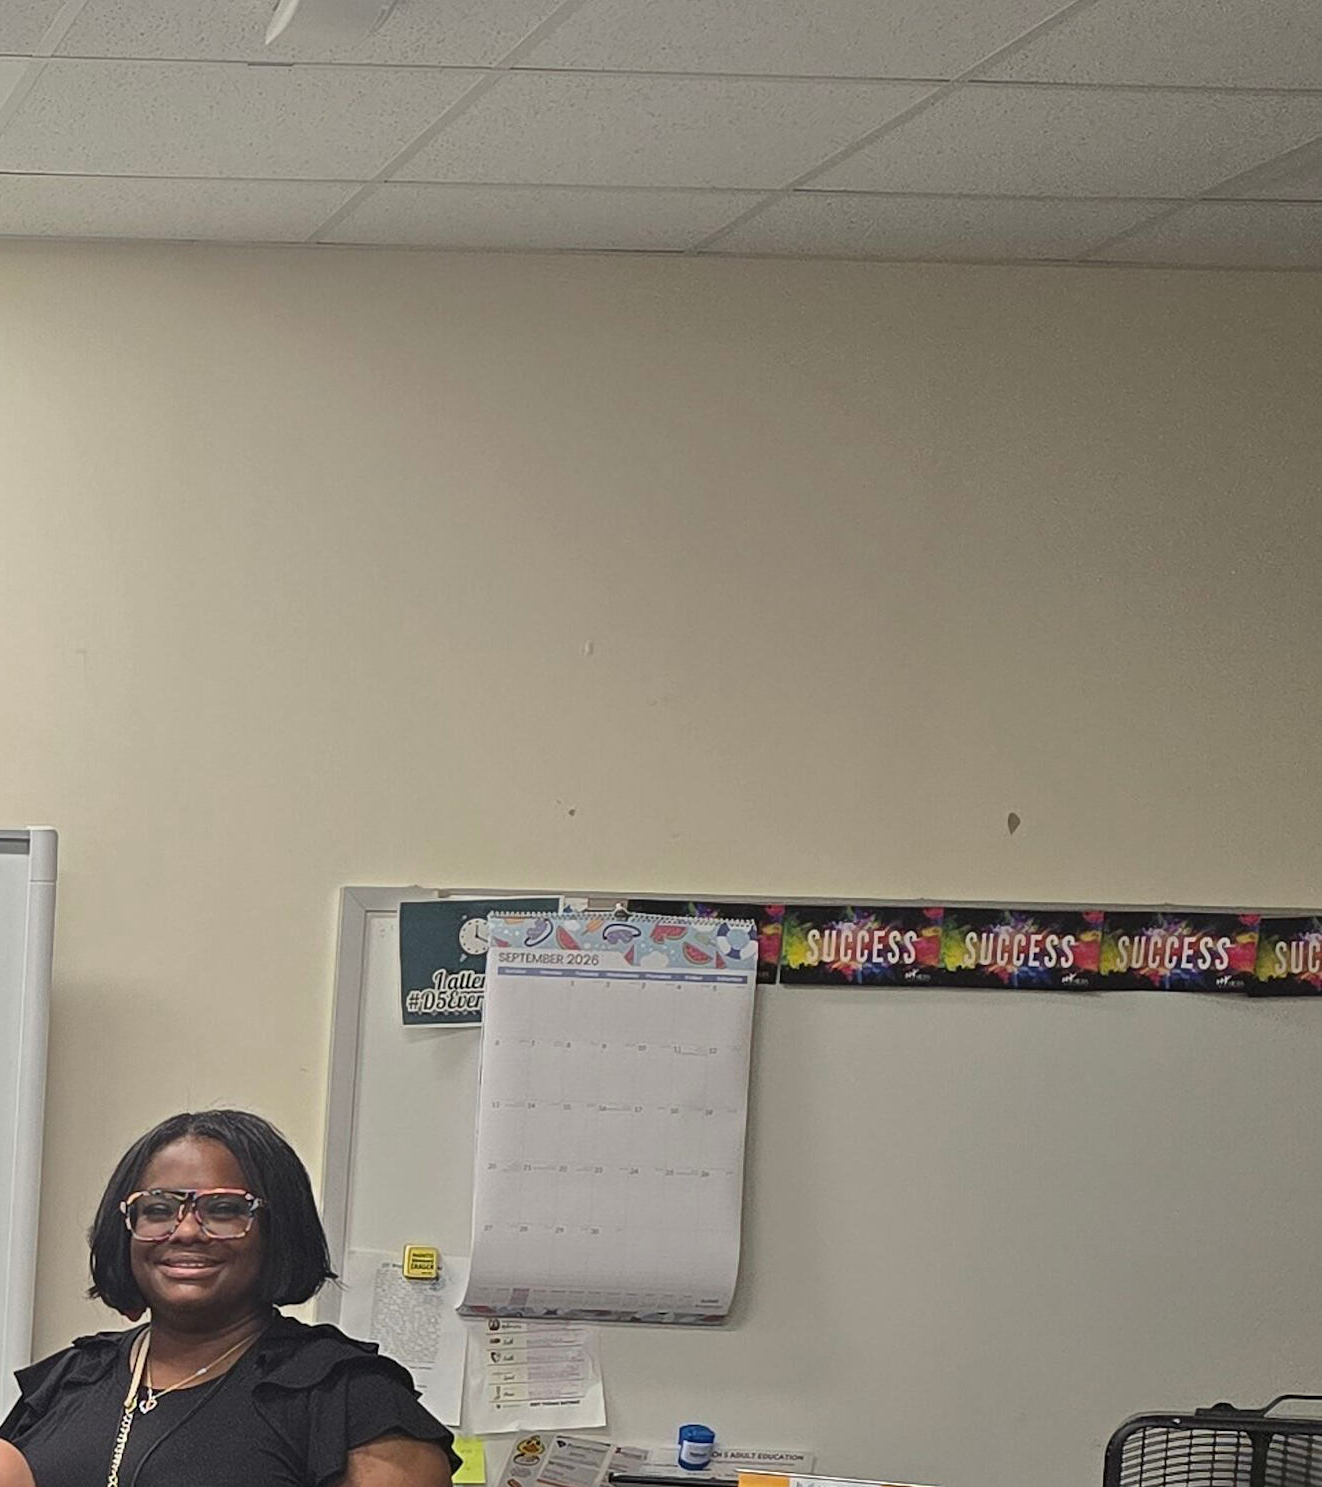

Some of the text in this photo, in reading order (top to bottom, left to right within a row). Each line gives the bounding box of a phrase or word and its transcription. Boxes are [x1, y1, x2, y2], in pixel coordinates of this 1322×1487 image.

[498, 952, 599, 966] SEPTEMBER 2026
[807, 928, 918, 964] SUCCESS
[964, 931, 1077, 969] SUCCESS
[1116, 935, 1232, 970] SUCCESS
[757, 1453, 804, 1461] EDUCATION
